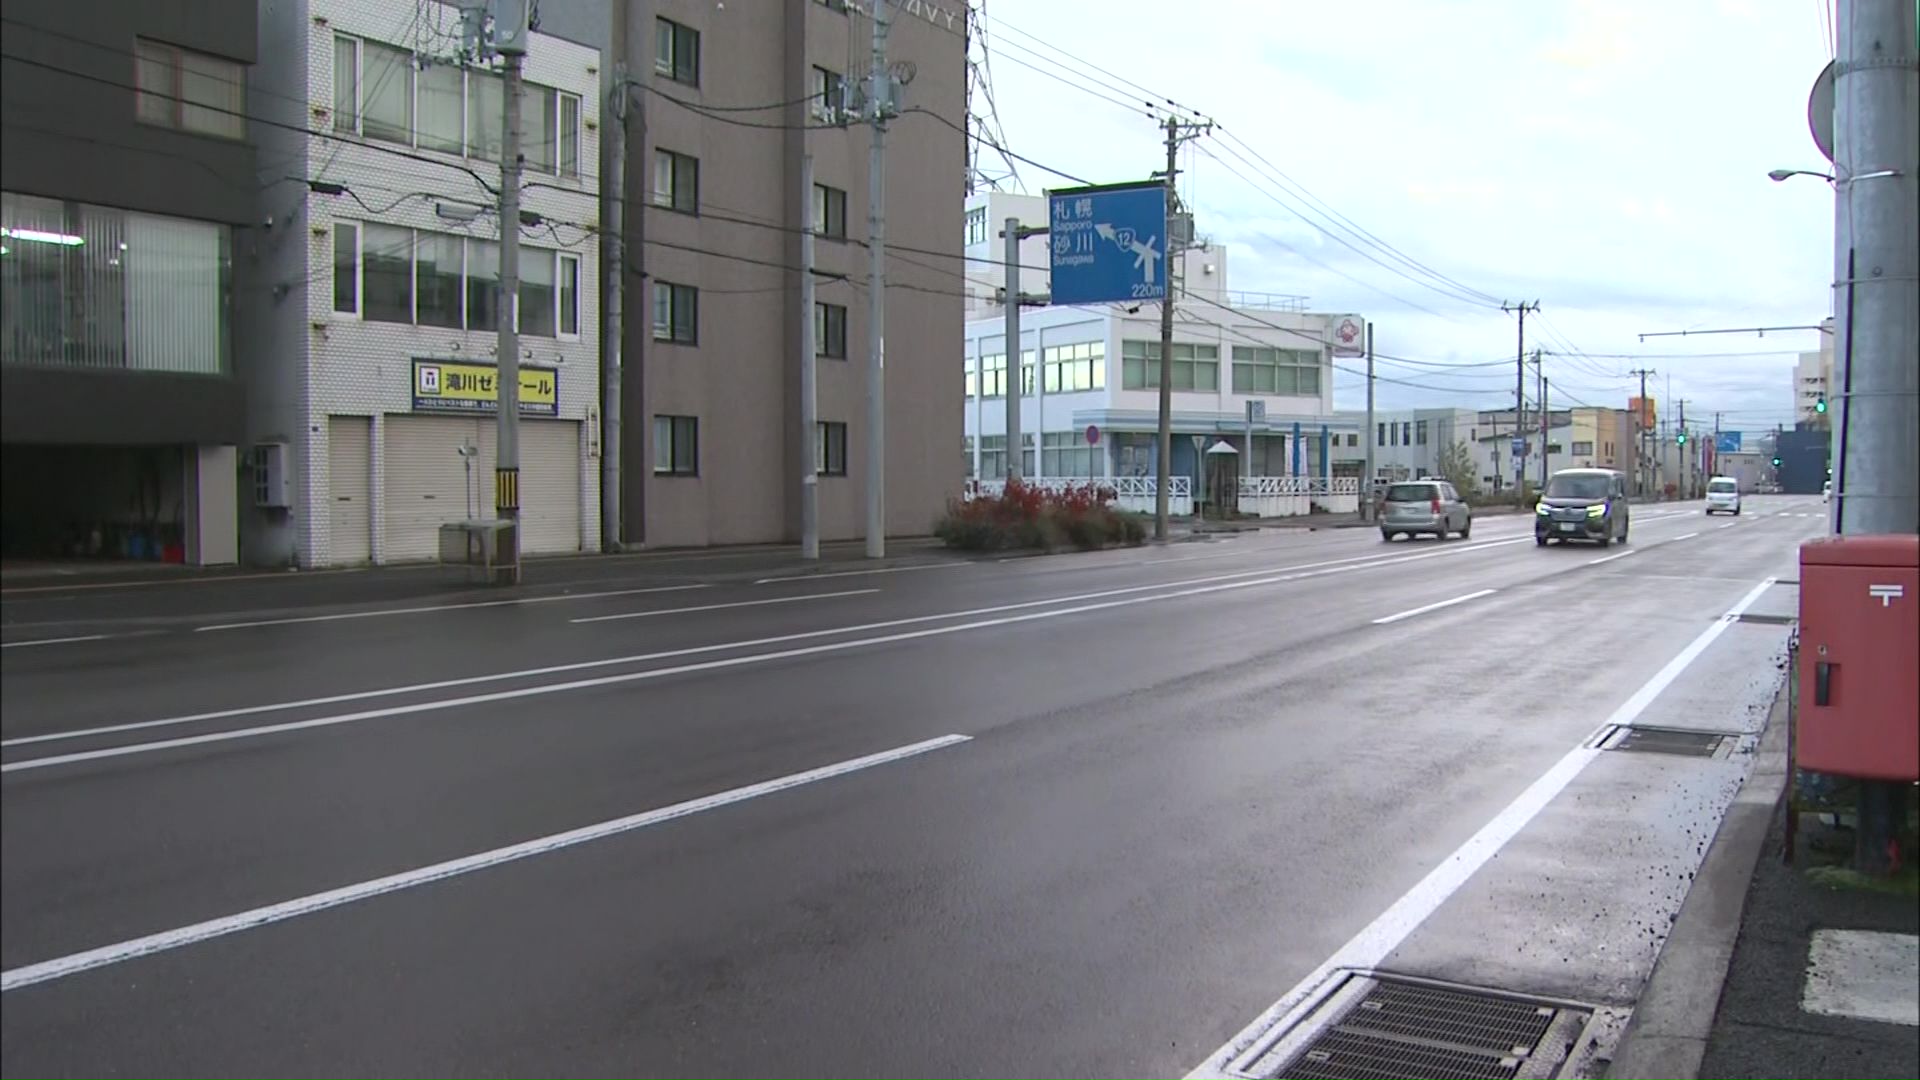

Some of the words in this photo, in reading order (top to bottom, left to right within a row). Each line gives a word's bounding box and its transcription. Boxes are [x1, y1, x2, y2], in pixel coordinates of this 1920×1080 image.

[1053, 198, 1093, 219] 札幌
[1053, 220, 1093, 232] Sapporo
[1053, 231, 1093, 254] 砂川
[1118, 232, 1131, 246] 12
[1053, 255, 1095, 266] Sunagawa
[1131, 283, 1163, 298] 220m
[446, 372, 552, 395] 滝川ゼール
